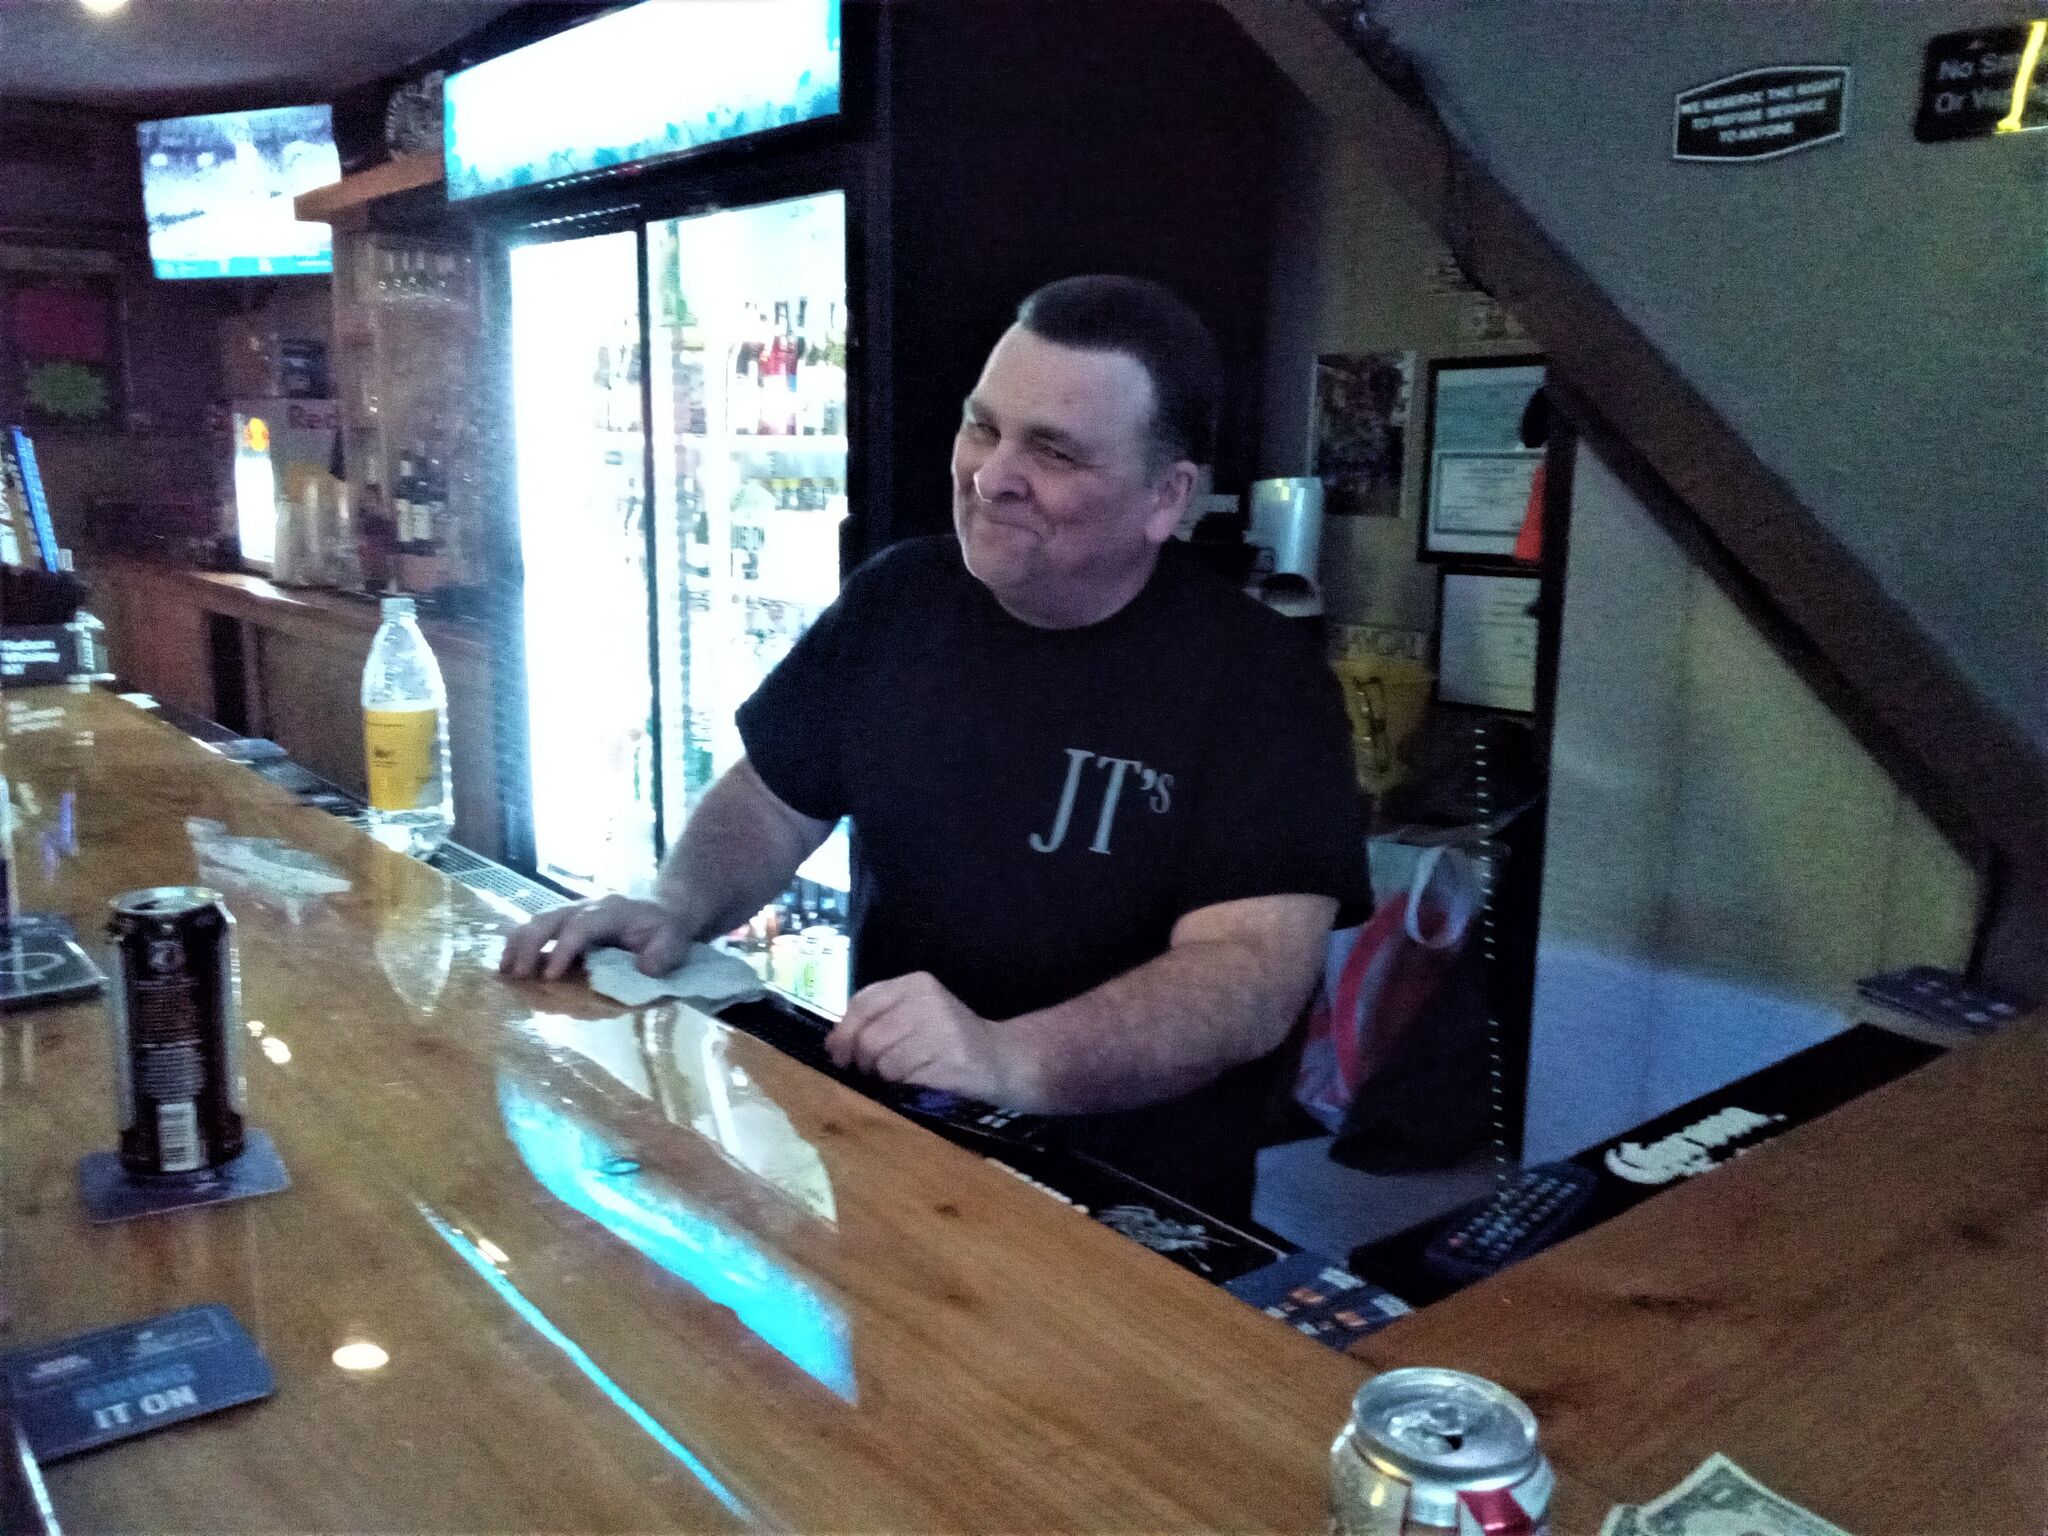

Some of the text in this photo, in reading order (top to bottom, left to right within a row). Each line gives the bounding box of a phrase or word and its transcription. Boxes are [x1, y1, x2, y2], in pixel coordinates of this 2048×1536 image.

[1028, 747, 1175, 855] JT's
[93, 1385, 198, 1429] IT ON
